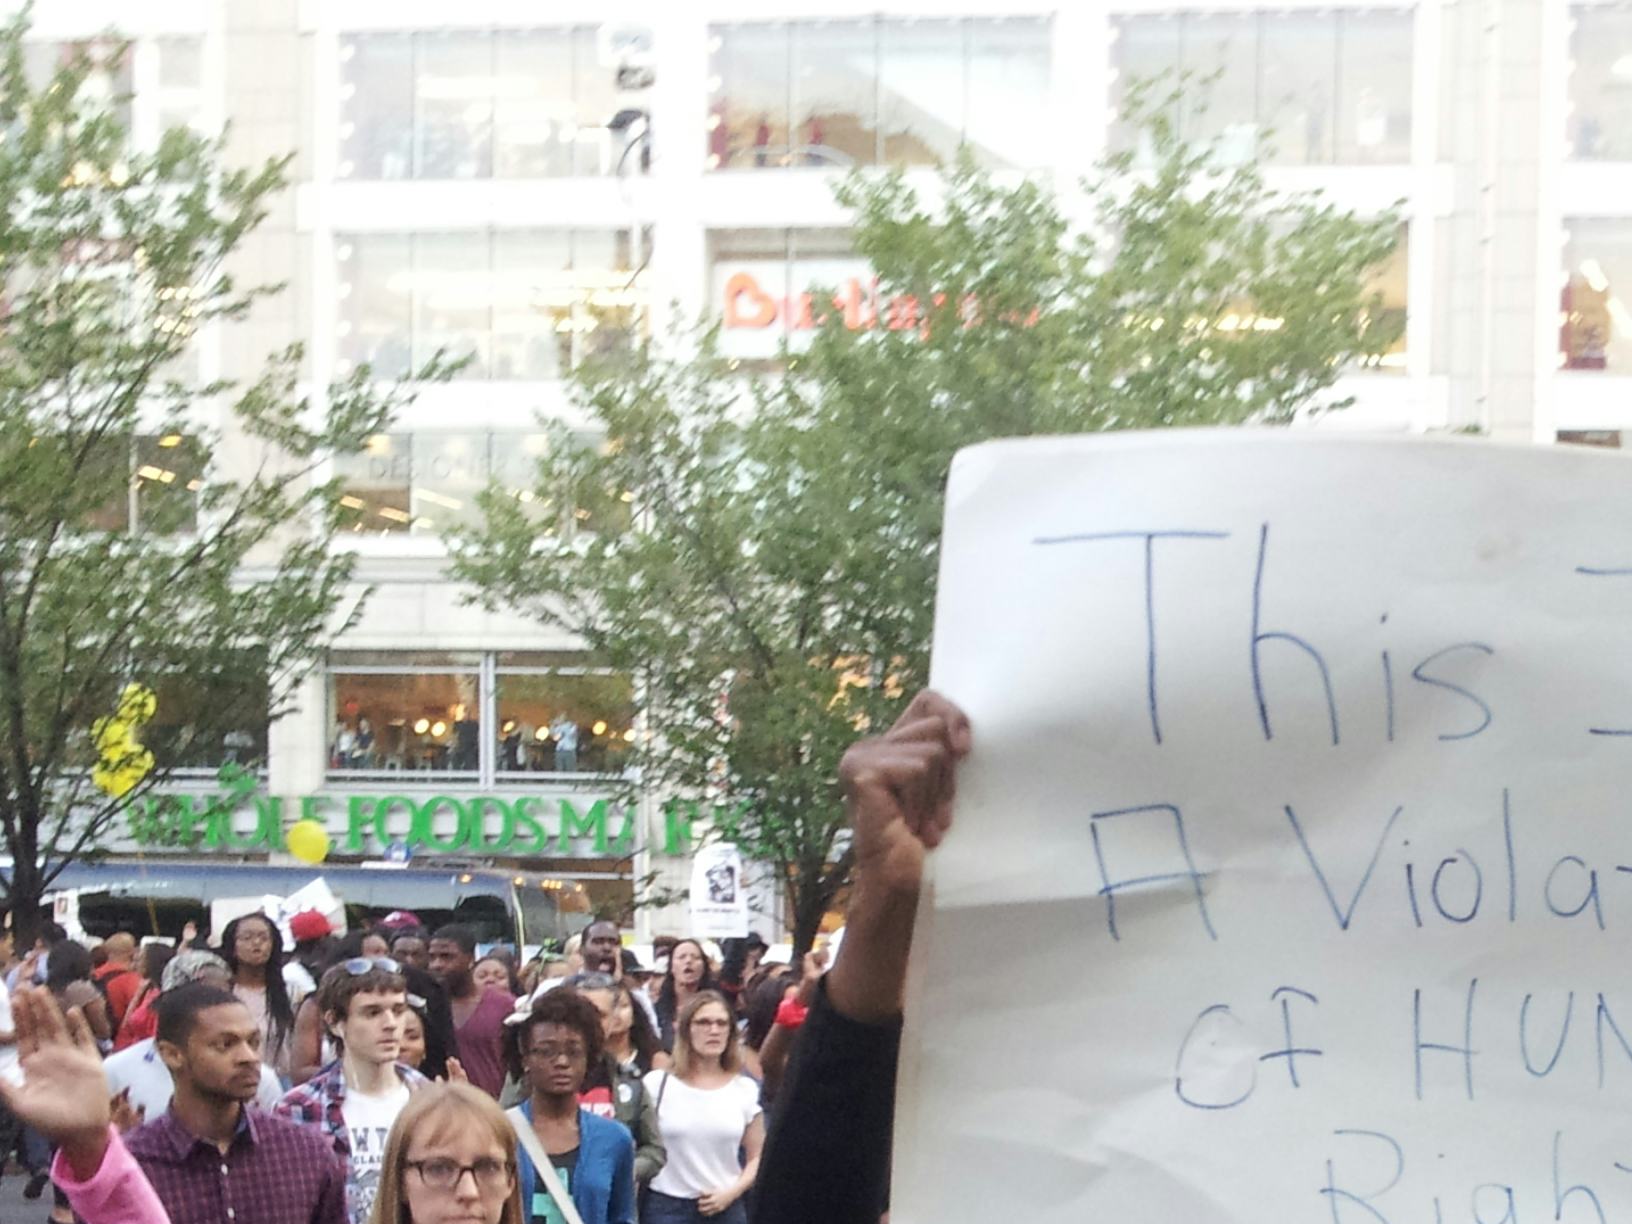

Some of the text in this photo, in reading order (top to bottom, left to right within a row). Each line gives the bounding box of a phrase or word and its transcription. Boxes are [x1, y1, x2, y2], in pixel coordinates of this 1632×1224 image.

[1033, 523, 1495, 746] This
[346, 795, 550, 856] FOODS
[554, 797, 797, 859] MAR
[1090, 803, 1218, 941] A
